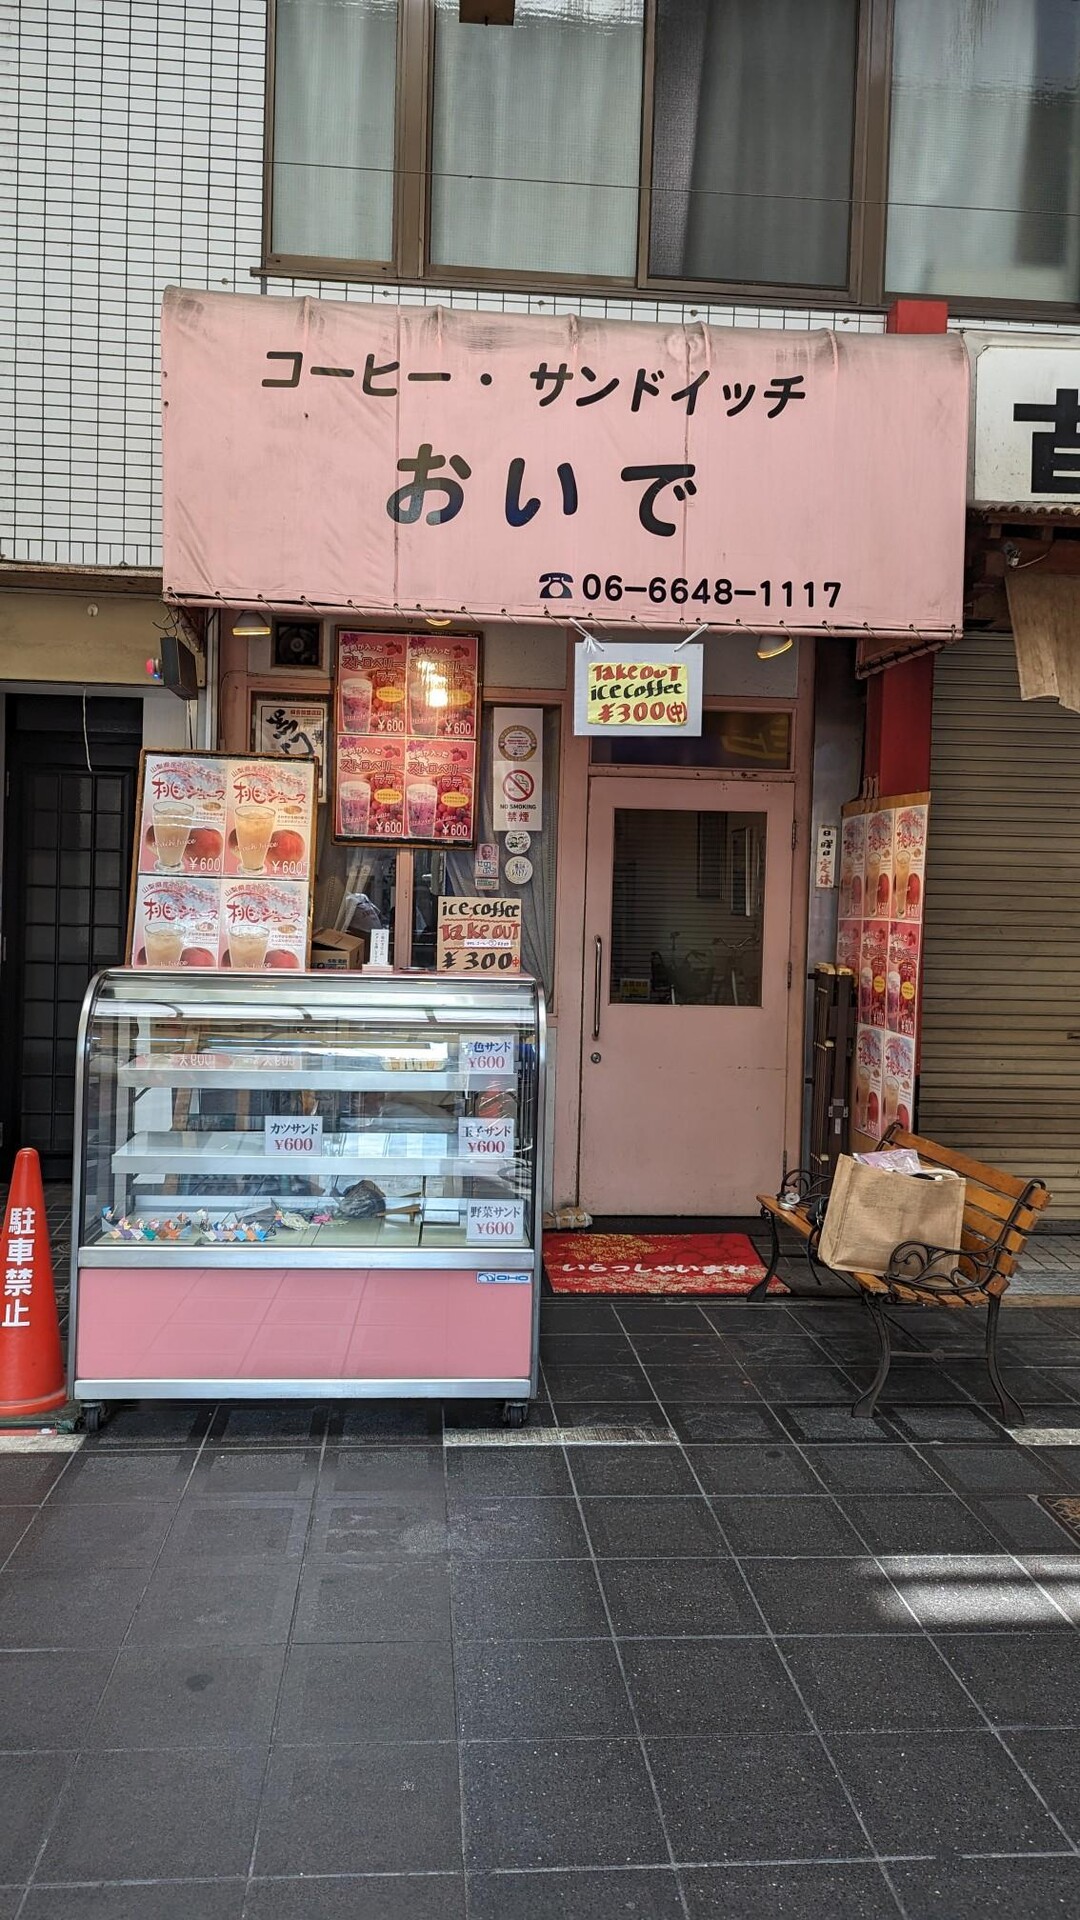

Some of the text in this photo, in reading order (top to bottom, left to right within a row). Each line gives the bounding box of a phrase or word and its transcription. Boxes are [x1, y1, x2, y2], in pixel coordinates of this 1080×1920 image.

[387, 443, 697, 537] おいで
[582, 572, 842, 609] 06-6648-1117
[342, 656, 406, 669] ストロベリー
[378, 720, 404, 732] ¥600
[445, 722, 471, 734] ¥600
[340, 759, 405, 772] ストロベリー
[407, 761, 472, 775] ストロベリー
[374, 773, 396, 785] ラテ
[441, 776, 462, 788] ラテ
[152, 778, 225, 800] 桃ジュース
[233, 782, 306, 804] 桃ジュース
[507, 811, 530, 822] 禁煙
[376, 822, 402, 833] ¥600
[442, 824, 468, 836] ¥600
[189, 856, 221, 871] ¥600
[272, 860, 304, 875] ¥600
[144, 899, 218, 920] 桃ジュース
[226, 902, 301, 923] 桃ジュース
[468, 1056, 505, 1069] ¥600
[270, 1123, 318, 1135] カツサンド
[274, 1138, 313, 1151] ¥600
[468, 1141, 505, 1153] ¥600
[470, 1206, 521, 1218] 野菜サンド
[477, 1222, 514, 1235] ¥600
[2, 1207, 36, 1327] 駐車禁止
[562, 1264, 749, 1274] いらっしゃいませ
